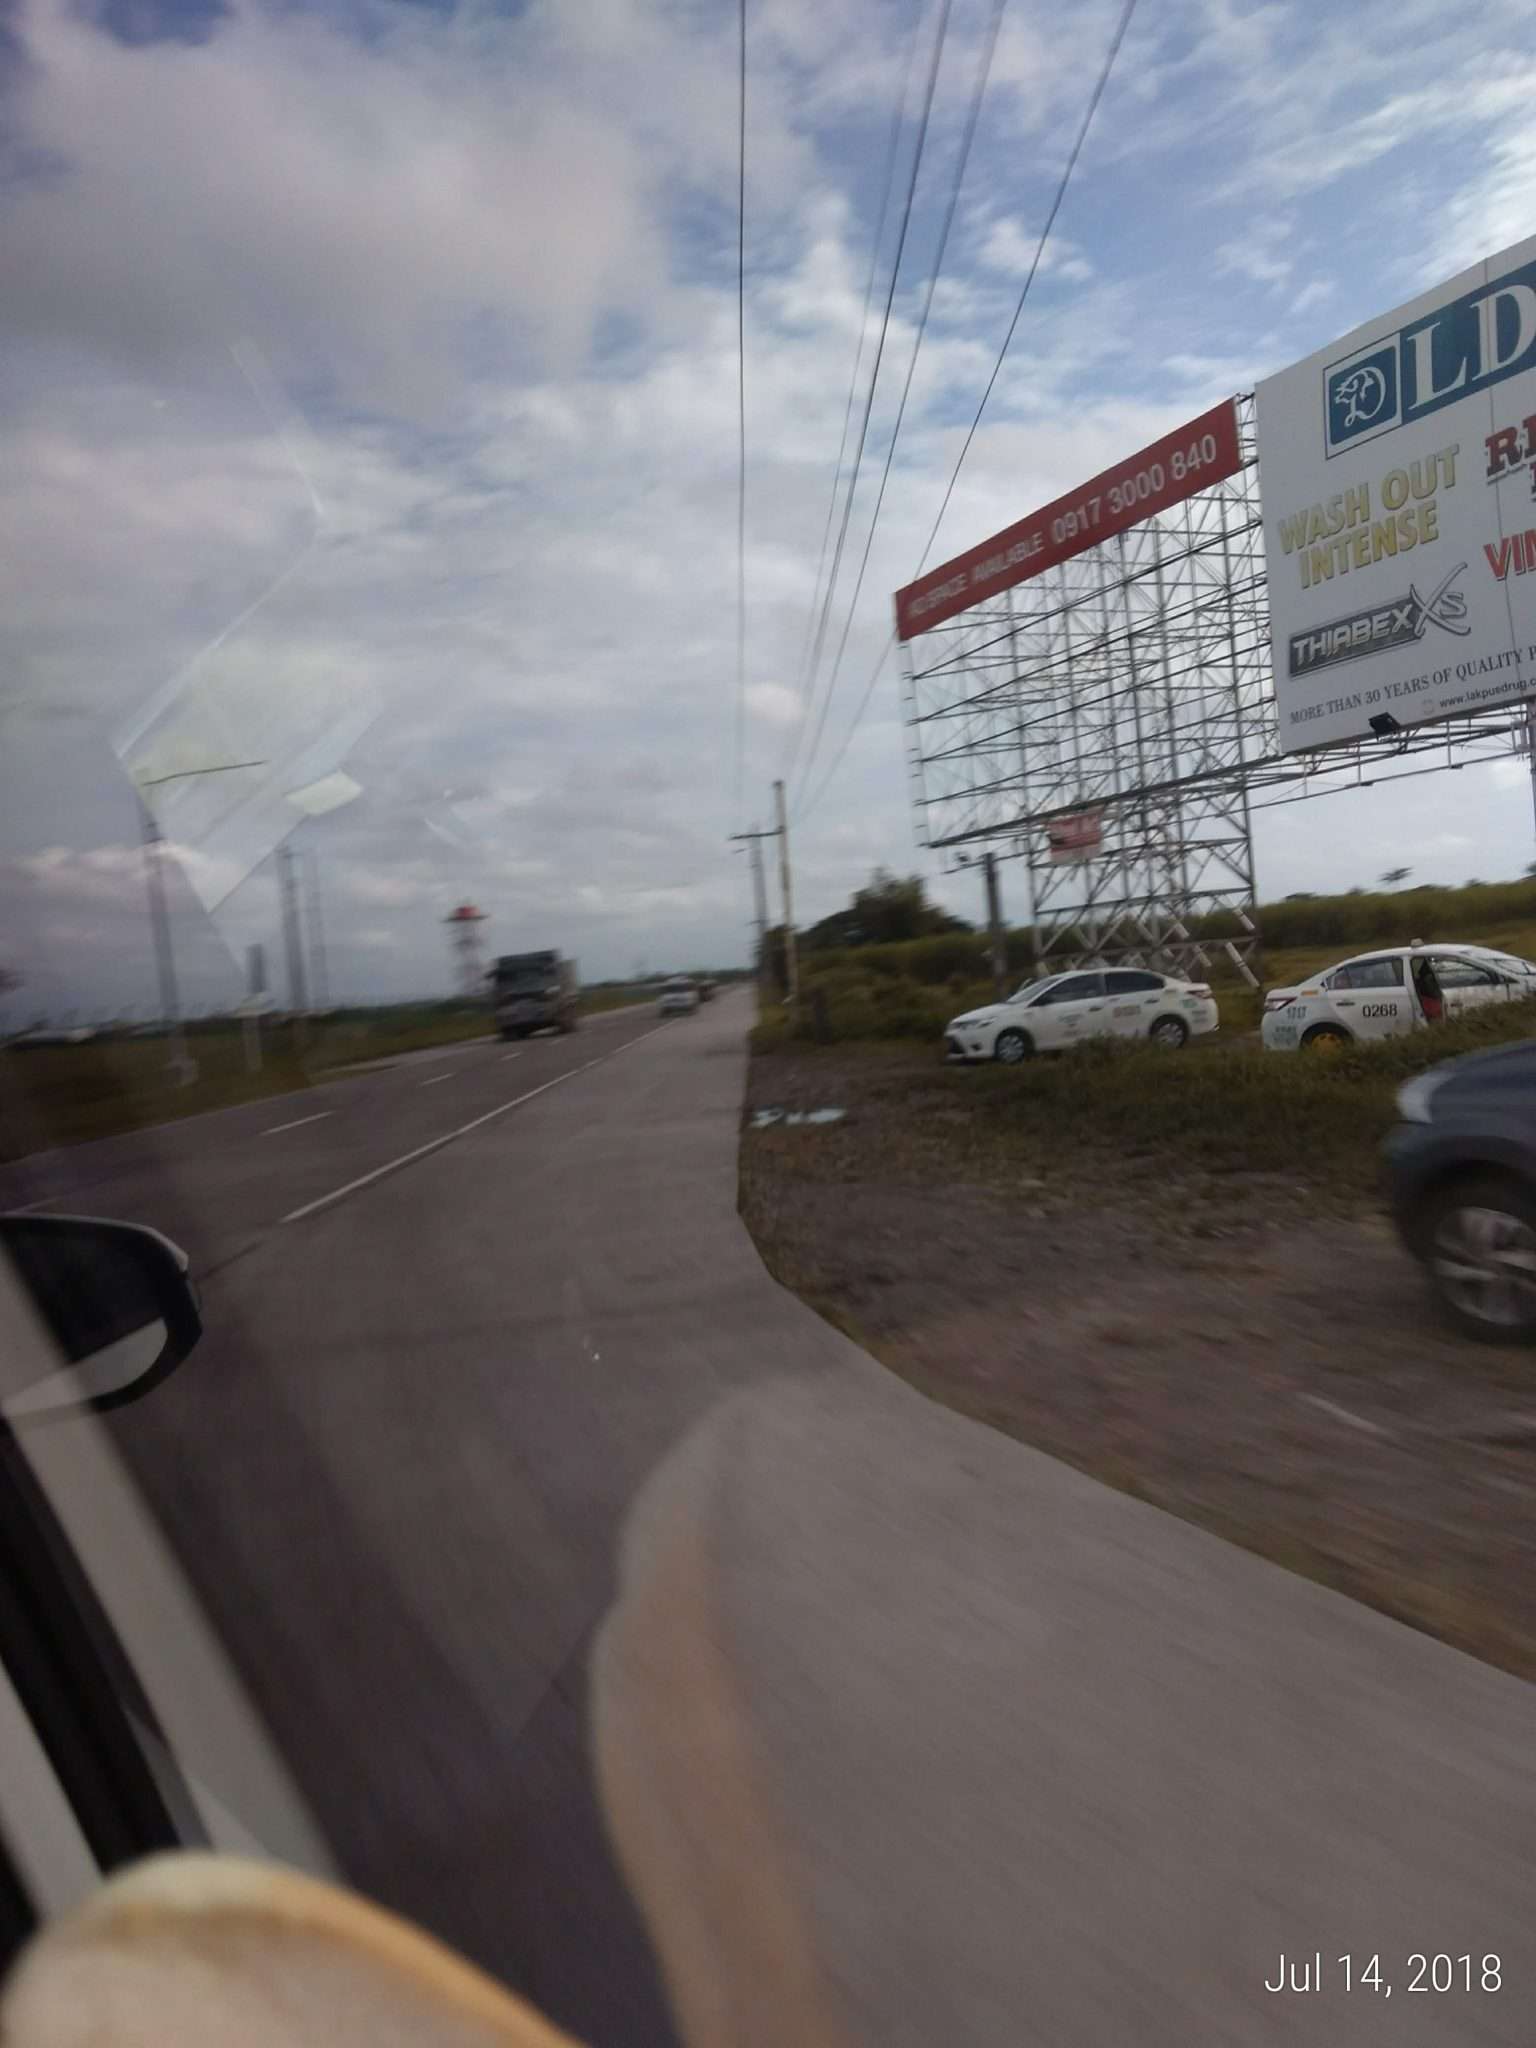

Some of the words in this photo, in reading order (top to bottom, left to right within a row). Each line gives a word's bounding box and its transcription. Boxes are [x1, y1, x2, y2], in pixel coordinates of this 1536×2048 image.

[1052, 498, 1101, 544] 0917
[1107, 464, 1166, 515] 3000
[1171, 433, 1217, 481] 840
[1277, 482, 1371, 555] WASH
[1380, 443, 1461, 512] OUT
[1298, 499, 1440, 590] INTENSE
[1290, 706, 1323, 725] MORE
[1328, 693, 1363, 716] THAN
[1365, 688, 1382, 704] 30
[1384, 674, 1430, 698] YEARS
[1432, 667, 1452, 685] OF
[1455, 647, 1523, 681] QUALITY
[1362, 1003, 1398, 1019] 0268
